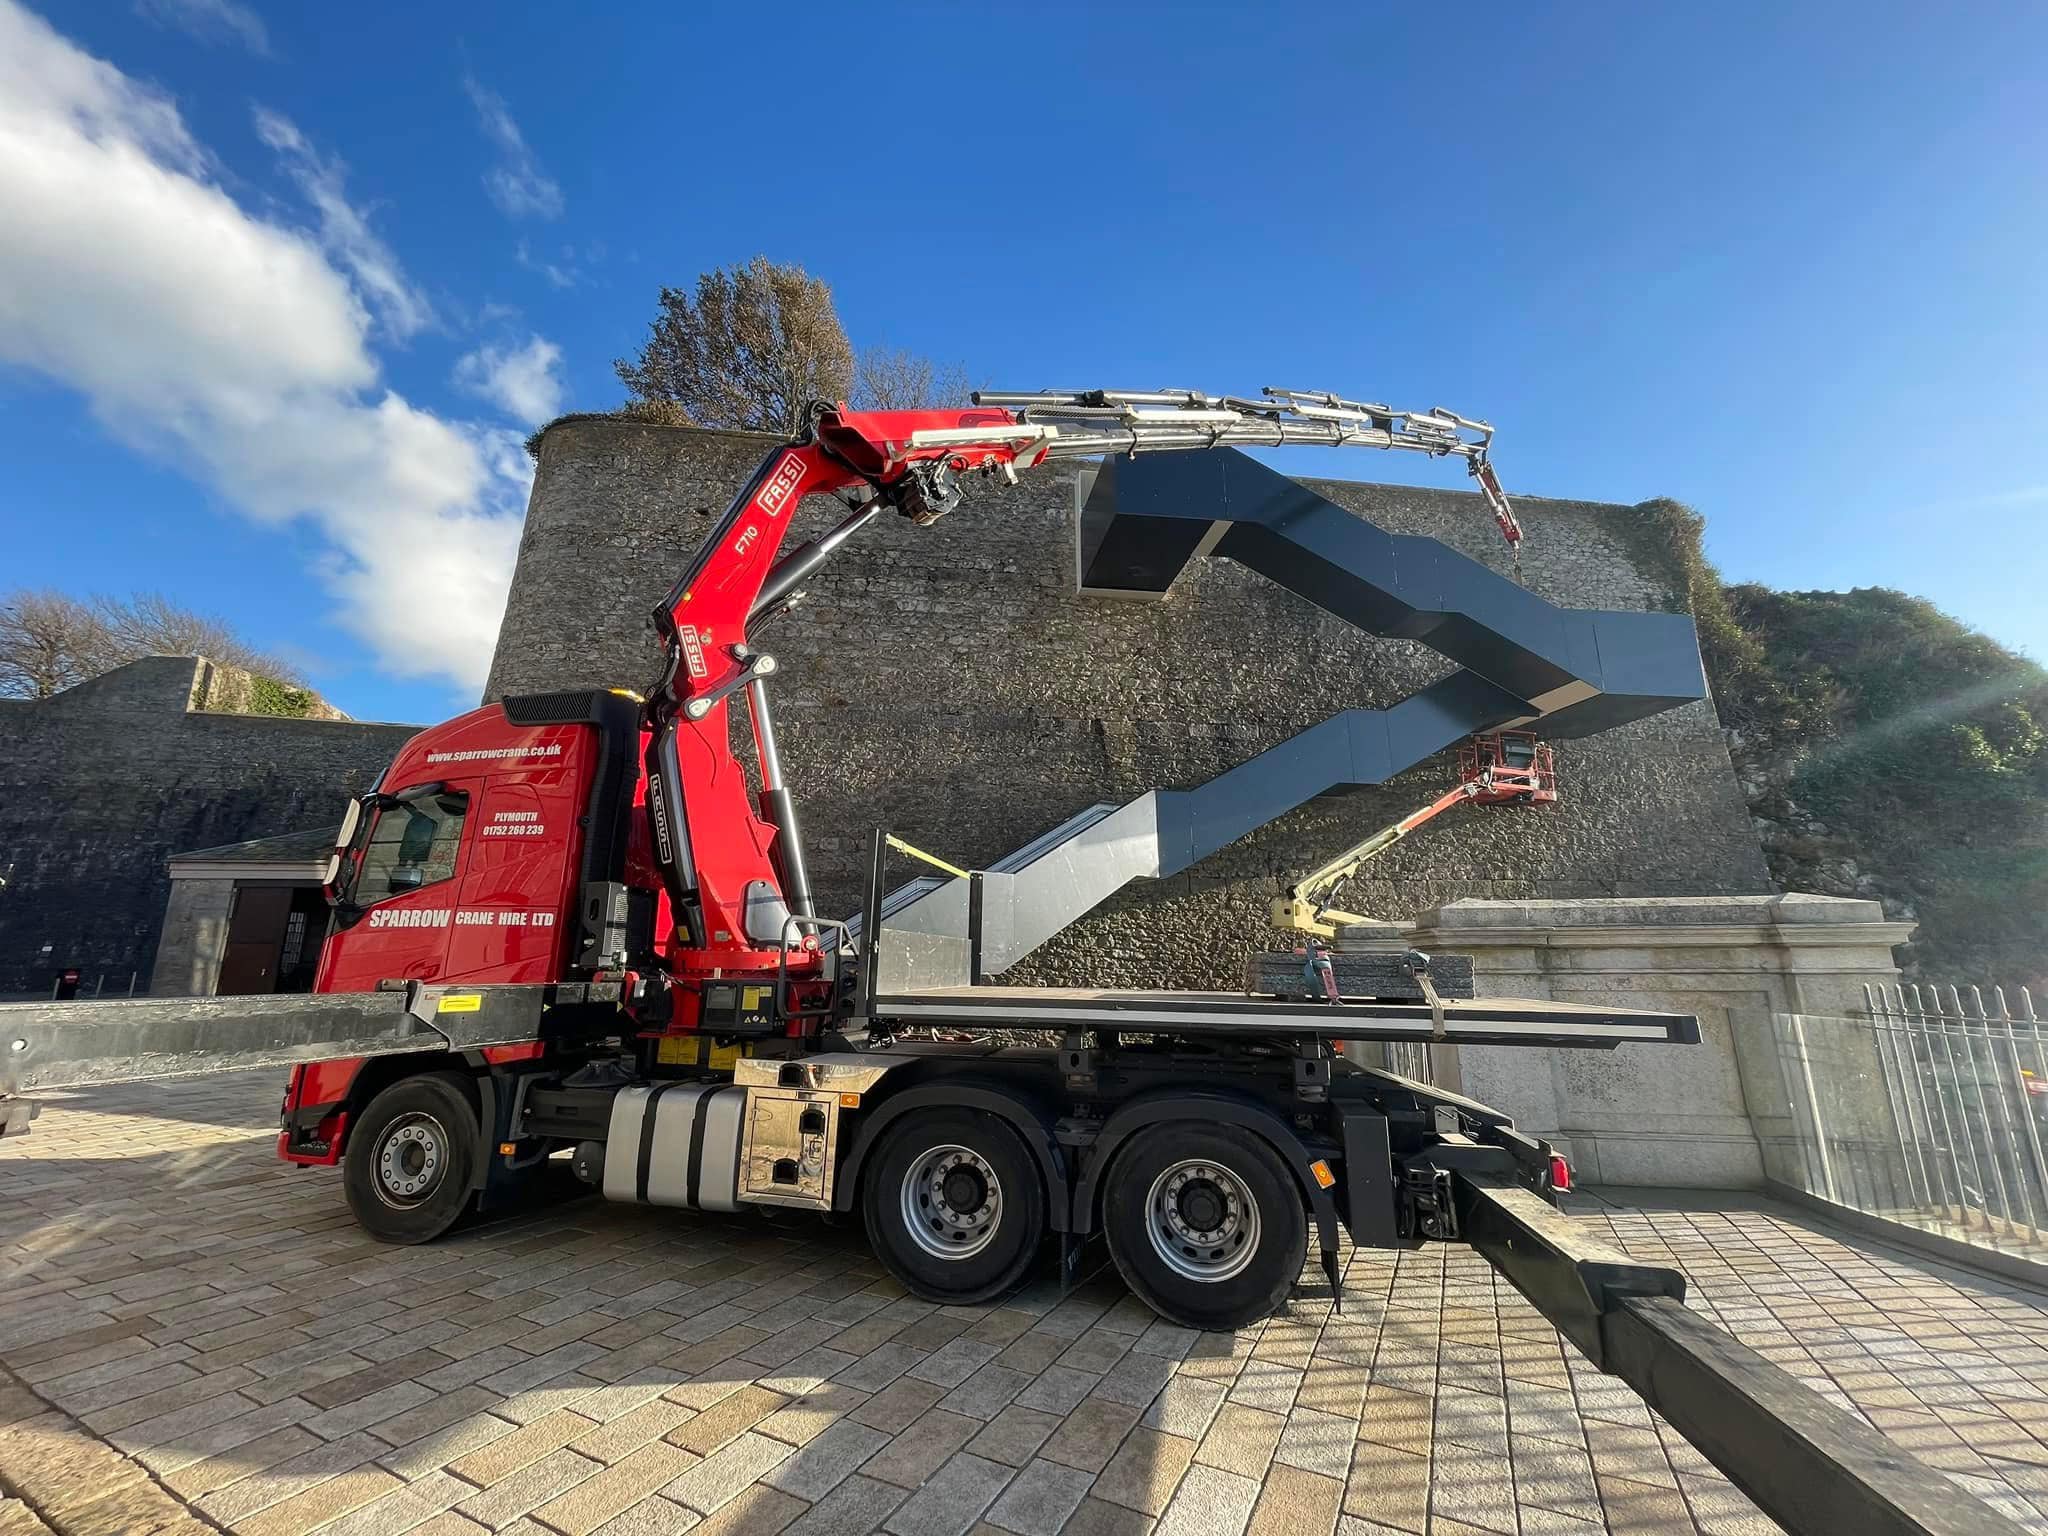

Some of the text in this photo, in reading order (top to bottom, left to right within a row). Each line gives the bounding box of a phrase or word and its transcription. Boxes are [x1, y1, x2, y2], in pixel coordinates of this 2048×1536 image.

[762, 459, 802, 510] FASSI
[735, 526, 758, 555] F710
[683, 629, 704, 673] FASSI
[427, 744, 561, 763] www.sparrowcrane.co.uk
[494, 812, 538, 822] PLYMOUTH
[652, 779, 669, 859] FASSI
[483, 825, 544, 836] 01752 268 239
[369, 909, 554, 928] SPARROW CRANE HIRE LTD
